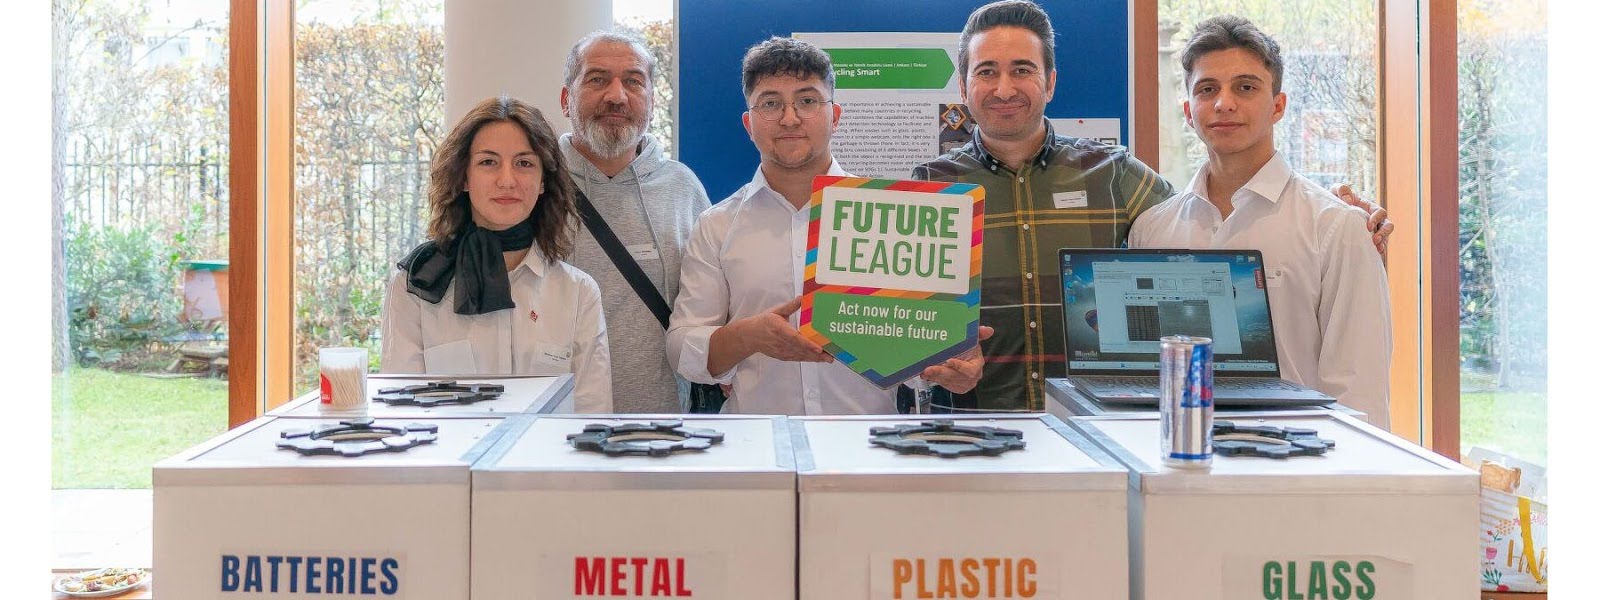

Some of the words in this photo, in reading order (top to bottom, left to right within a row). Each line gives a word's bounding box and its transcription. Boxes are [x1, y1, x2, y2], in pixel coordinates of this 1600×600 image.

[834, 68, 854, 77] ycling
[833, 200, 960, 239] FUTURE
[829, 237, 958, 280] LEAGUE
[830, 320, 904, 338] sustainable
[908, 324, 948, 340] future
[838, 300, 859, 315] Act
[863, 306, 889, 318] now
[894, 305, 911, 319] for
[916, 310, 938, 321] our
[221, 555, 399, 594] BATTERIES
[574, 557, 692, 597] METAL
[892, 558, 1038, 599] PLASTIC
[1262, 560, 1377, 600] GLASS
